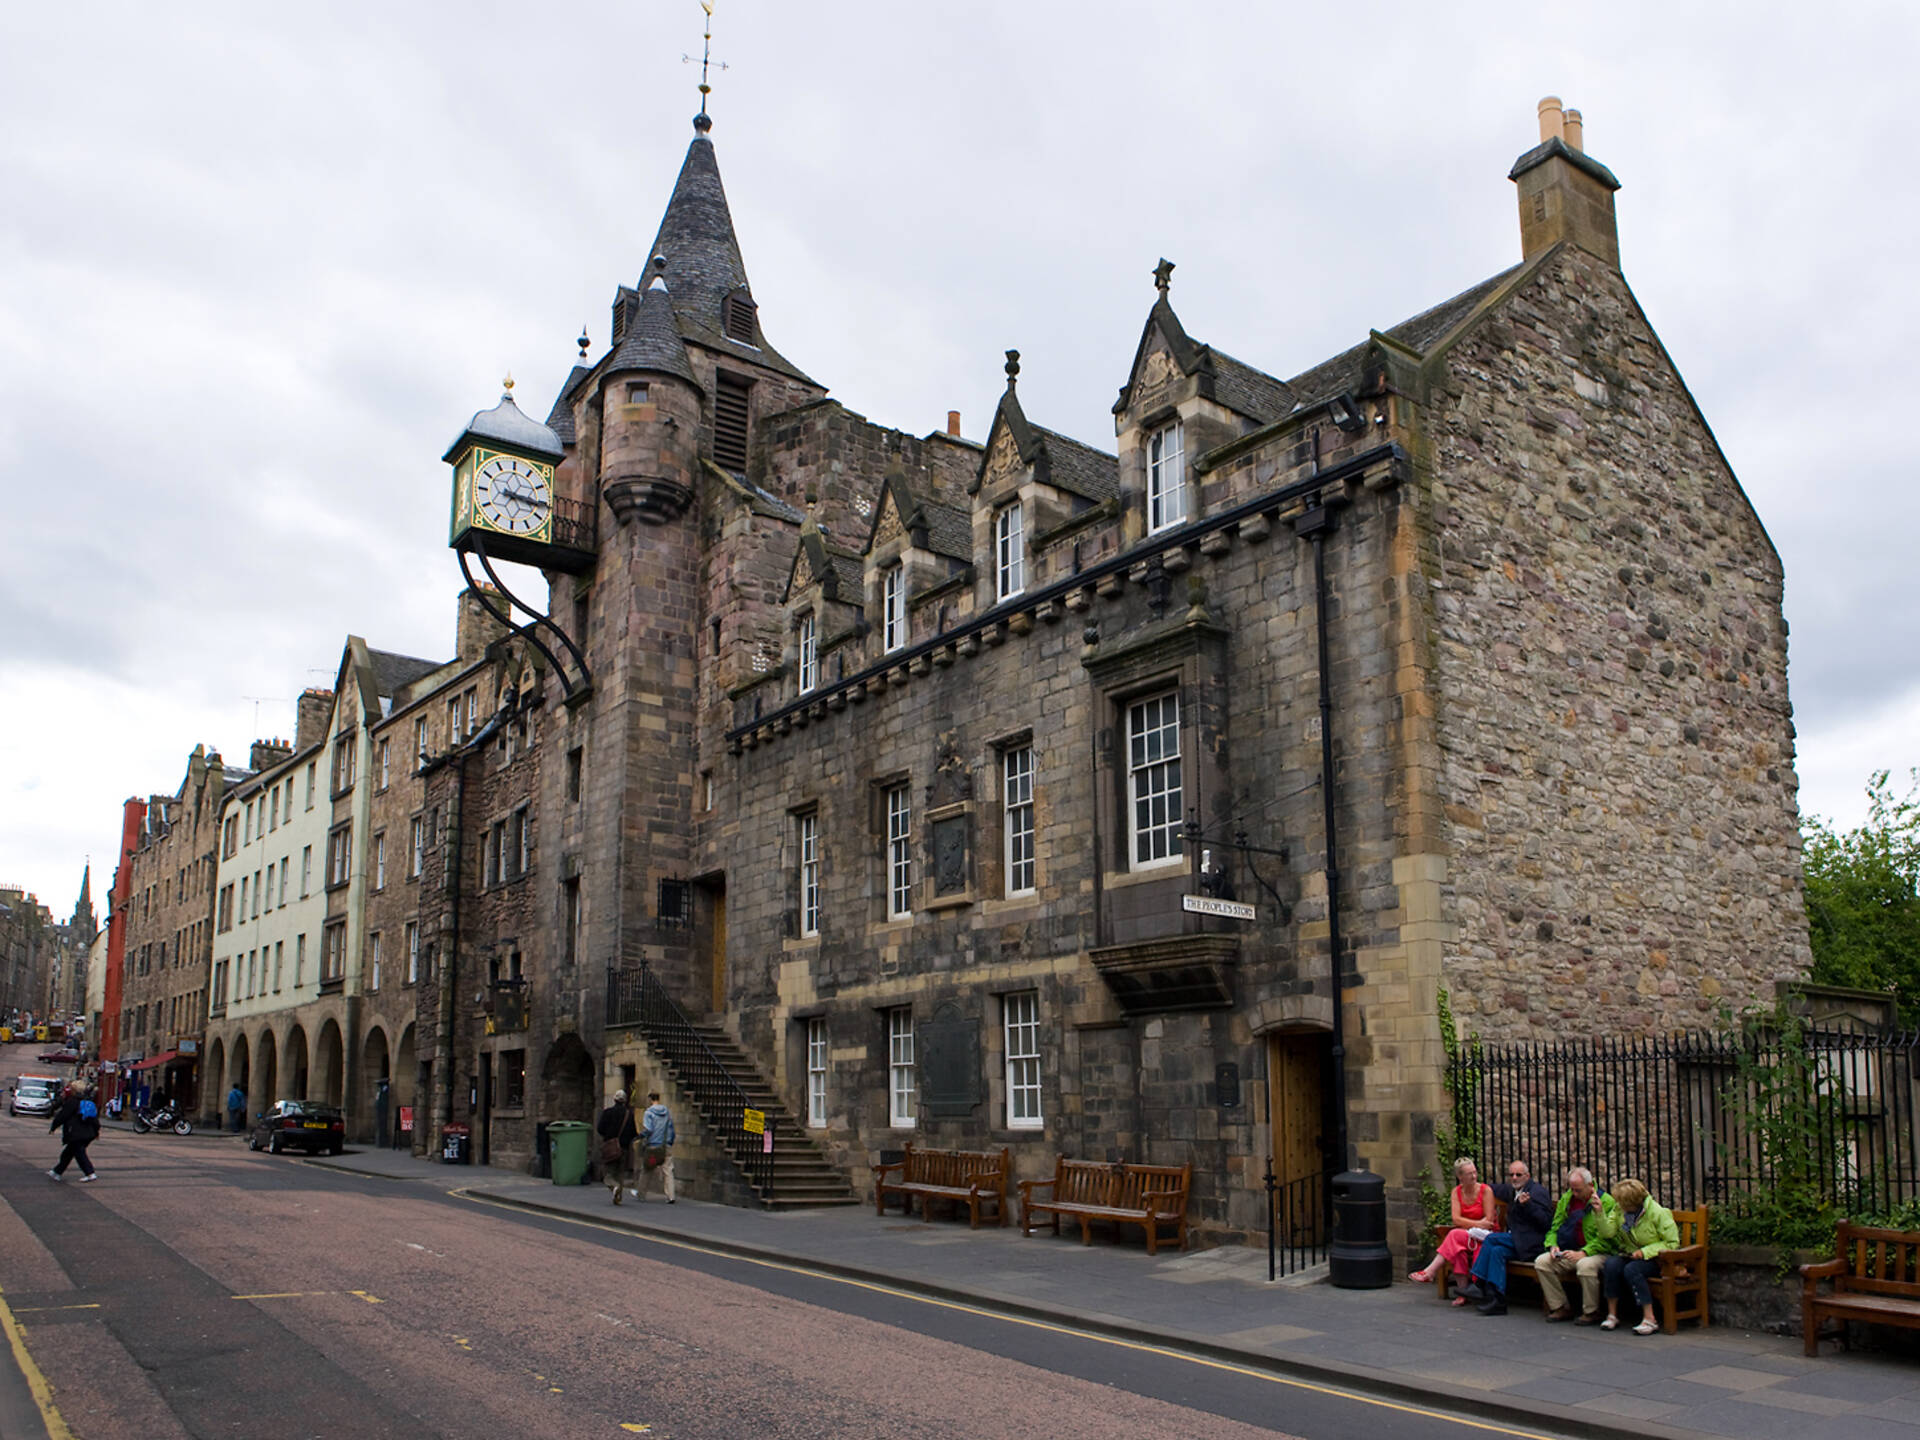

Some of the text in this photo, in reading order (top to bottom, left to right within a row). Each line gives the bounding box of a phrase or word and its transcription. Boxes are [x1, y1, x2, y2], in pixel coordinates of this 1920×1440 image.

[542, 466, 550, 478] 8
[475, 514, 483, 526] 8
[537, 529, 548, 540] 4
[1186, 898, 1253, 917] THE PEOPLE'S STORY
